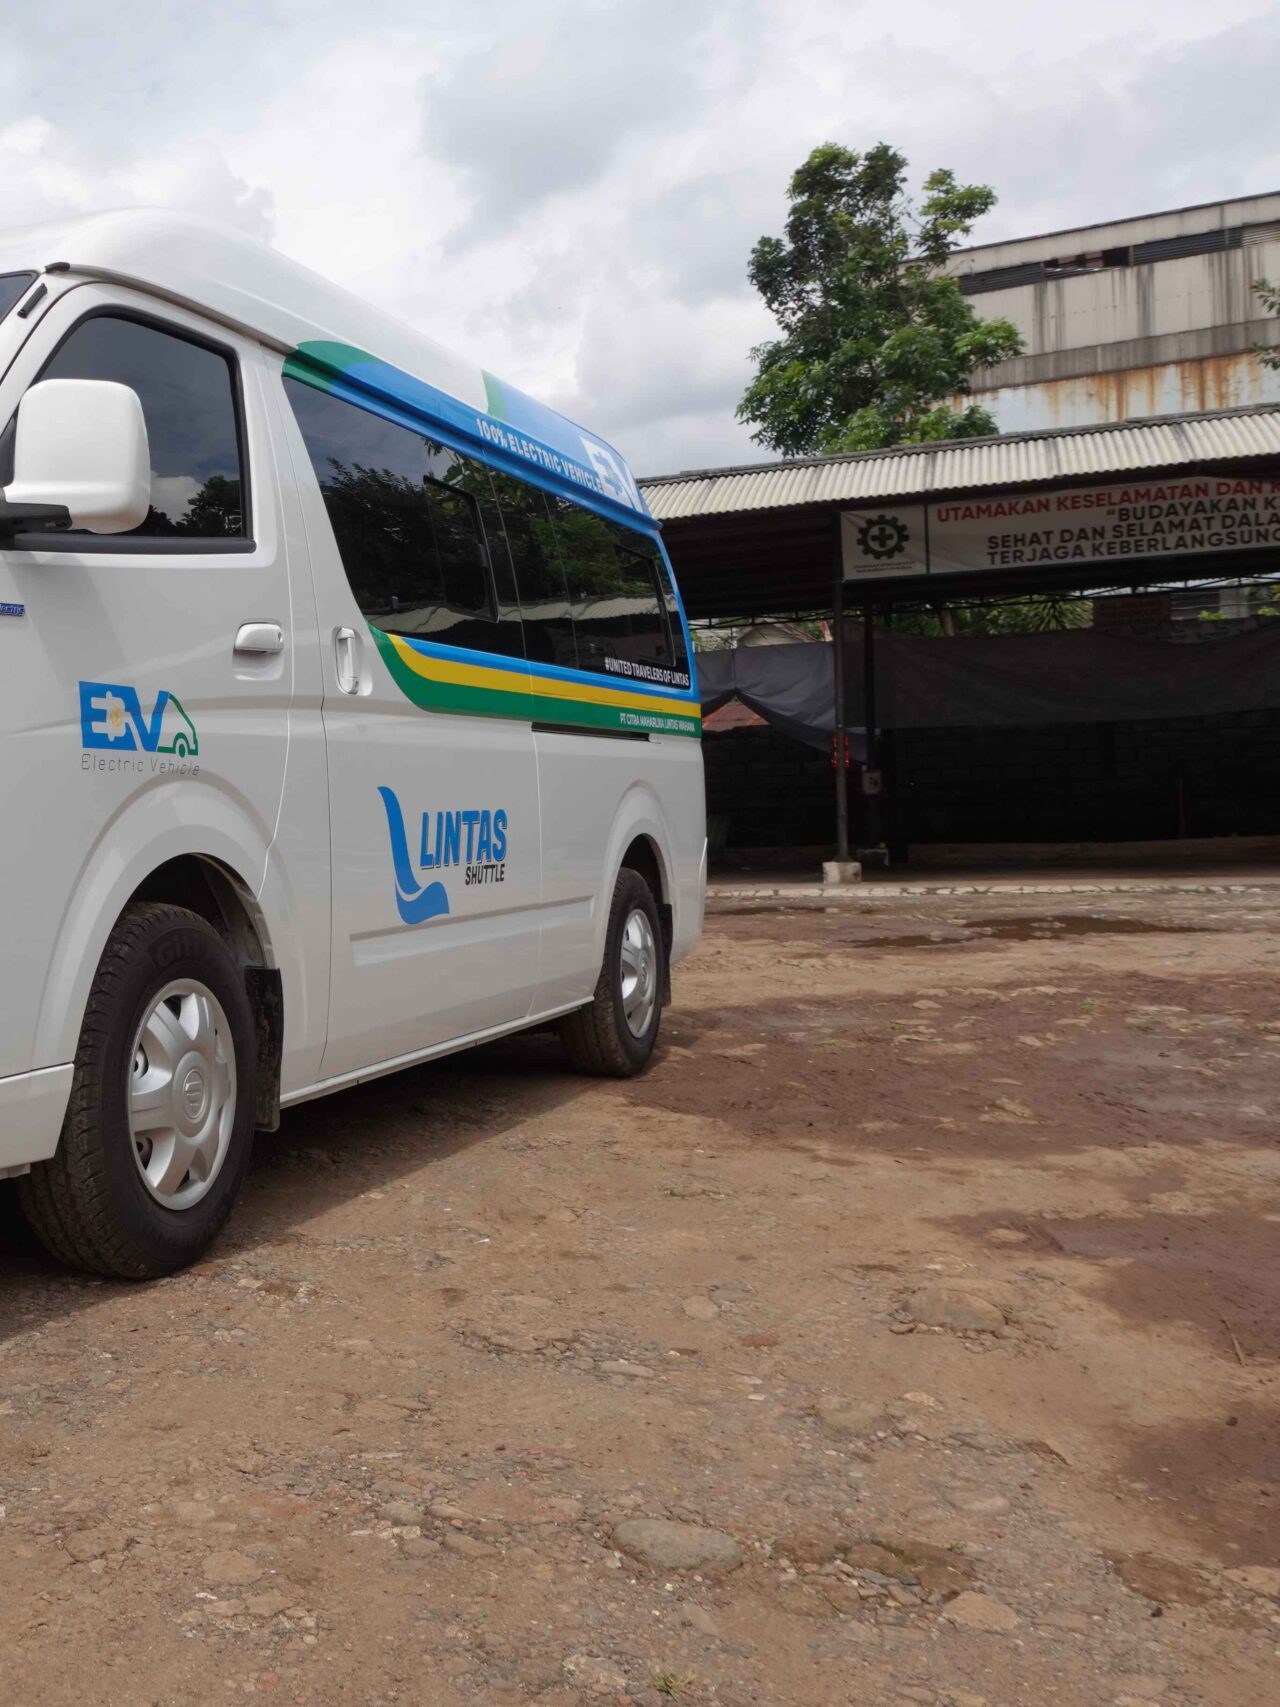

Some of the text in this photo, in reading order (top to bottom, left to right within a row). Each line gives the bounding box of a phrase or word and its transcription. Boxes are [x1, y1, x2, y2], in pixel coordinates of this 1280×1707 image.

[476, 418, 605, 494] 100% ELECTRIC VEHICLE
[937, 498, 1050, 523] UTAMAKAN
[1056, 482, 1209, 511] KESELAMATAN
[1216, 480, 1263, 496] DAN
[987, 530, 1054, 550] SEHAT
[1060, 526, 1105, 544] DAN
[1112, 516, 1215, 539] SELAMAT
[987, 544, 1085, 566] TERJAGA
[604, 656, 690, 687] #UNITED TRAVELERS OF LINTAS
[81, 753, 200, 776] Electric Vehicle
[420, 808, 508, 870] LINTAS
[465, 864, 505, 886] SHUTTLE
